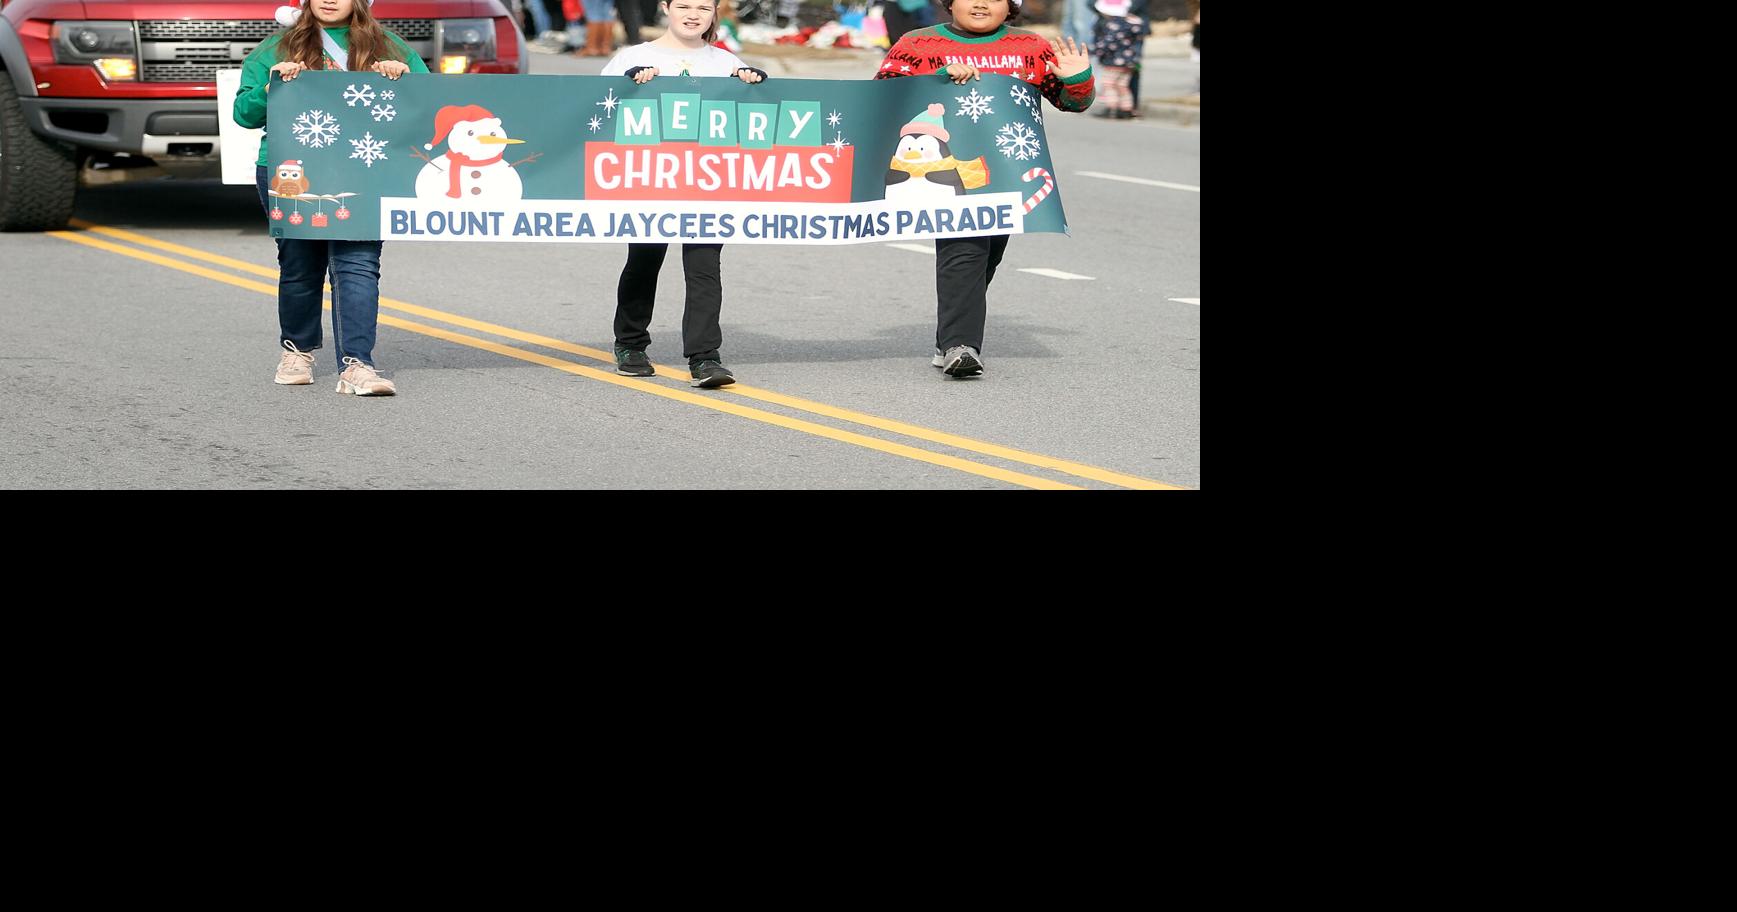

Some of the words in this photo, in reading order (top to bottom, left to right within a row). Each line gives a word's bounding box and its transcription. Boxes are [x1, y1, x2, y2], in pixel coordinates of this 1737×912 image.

[927, 56, 945, 69] MA
[1025, 55, 1035, 69] FA
[623, 100, 814, 141] MERRY
[593, 149, 834, 192] CHRISTMAS
[391, 209, 505, 235] BLOUNT
[512, 212, 596, 237] AREA
[604, 212, 735, 238] JAYCEES
[742, 211, 890, 240] CHRISTMAS
[896, 204, 1014, 235] PARADE
